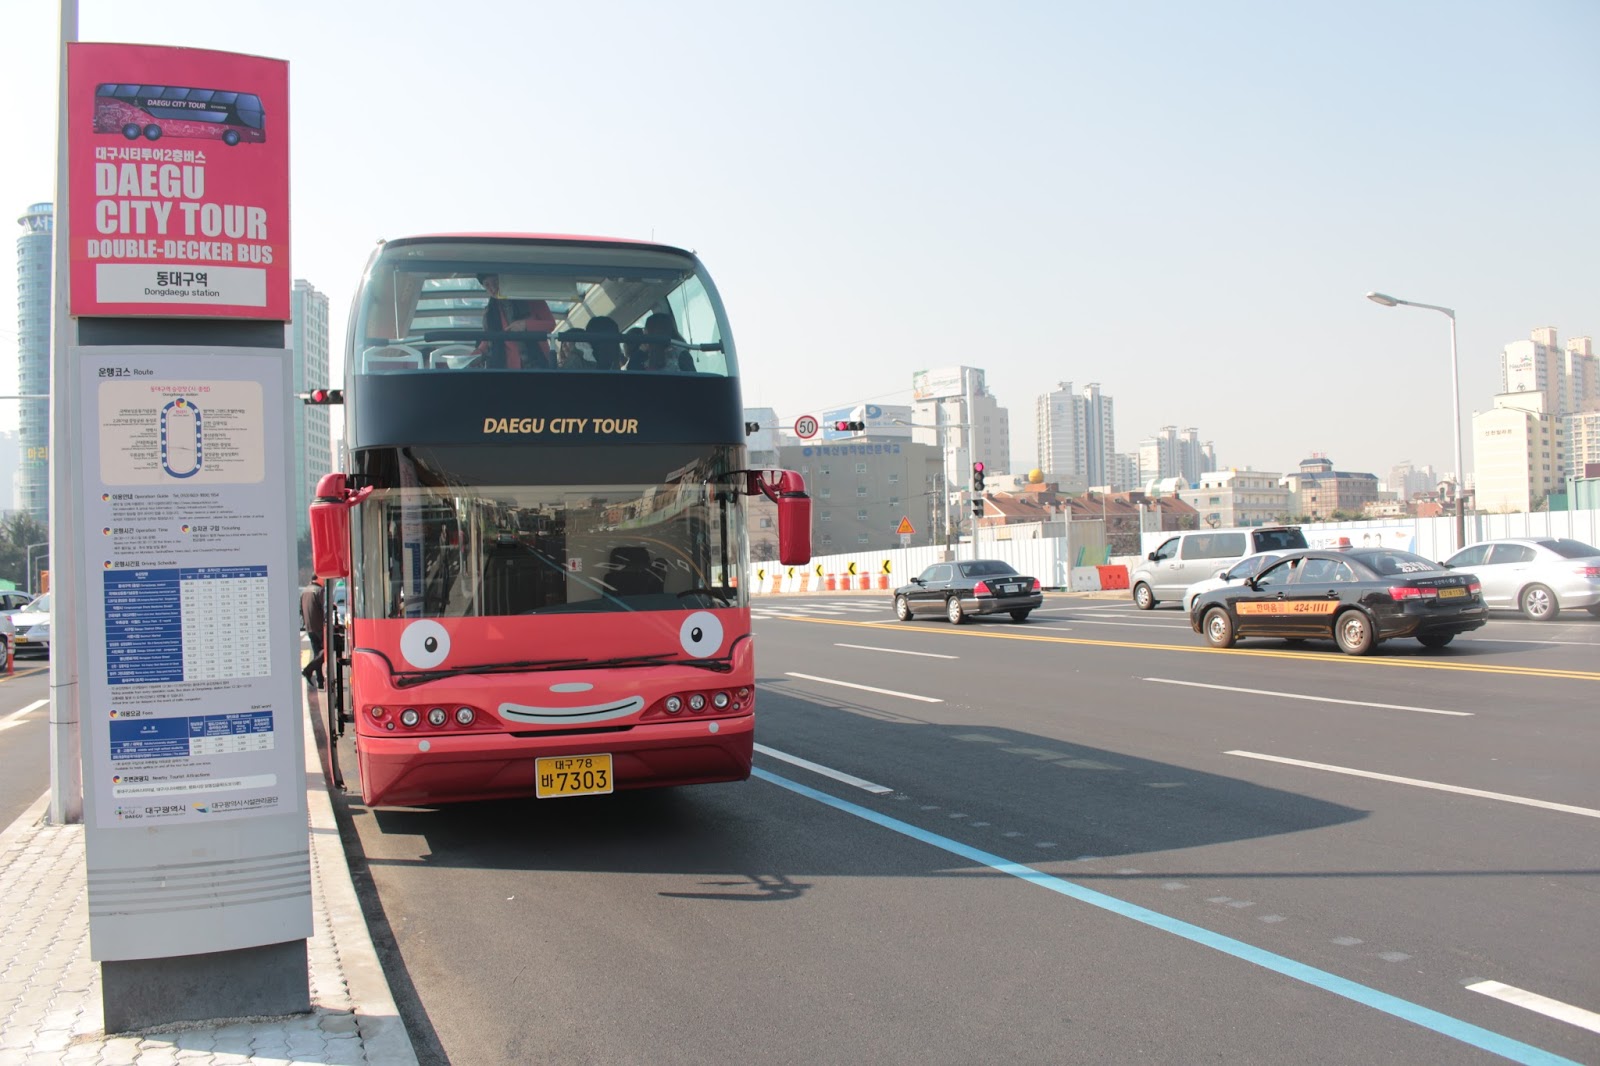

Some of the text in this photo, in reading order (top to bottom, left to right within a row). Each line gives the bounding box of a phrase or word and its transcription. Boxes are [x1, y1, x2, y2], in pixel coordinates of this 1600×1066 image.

[96, 147, 206, 164] 대구시티투어2층버스
[96, 163, 204, 199] DAEGU
[96, 200, 266, 239] CITY TOUR
[88, 239, 272, 264] DOUBLE-DECKER BUS
[157, 271, 208, 287] 동대구역
[144, 288, 219, 297] Dongdaegu station
[99, 368, 130, 377] 운행코스
[483, 418, 638, 433] DAEGU CITY TOUR
[800, 421, 813, 433] 50
[1294, 604, 1328, 612] 424-1111
[556, 759, 592, 770] 대구 78
[542, 770, 606, 791] 바7303
[145, 805, 186, 814] 대구광역시
